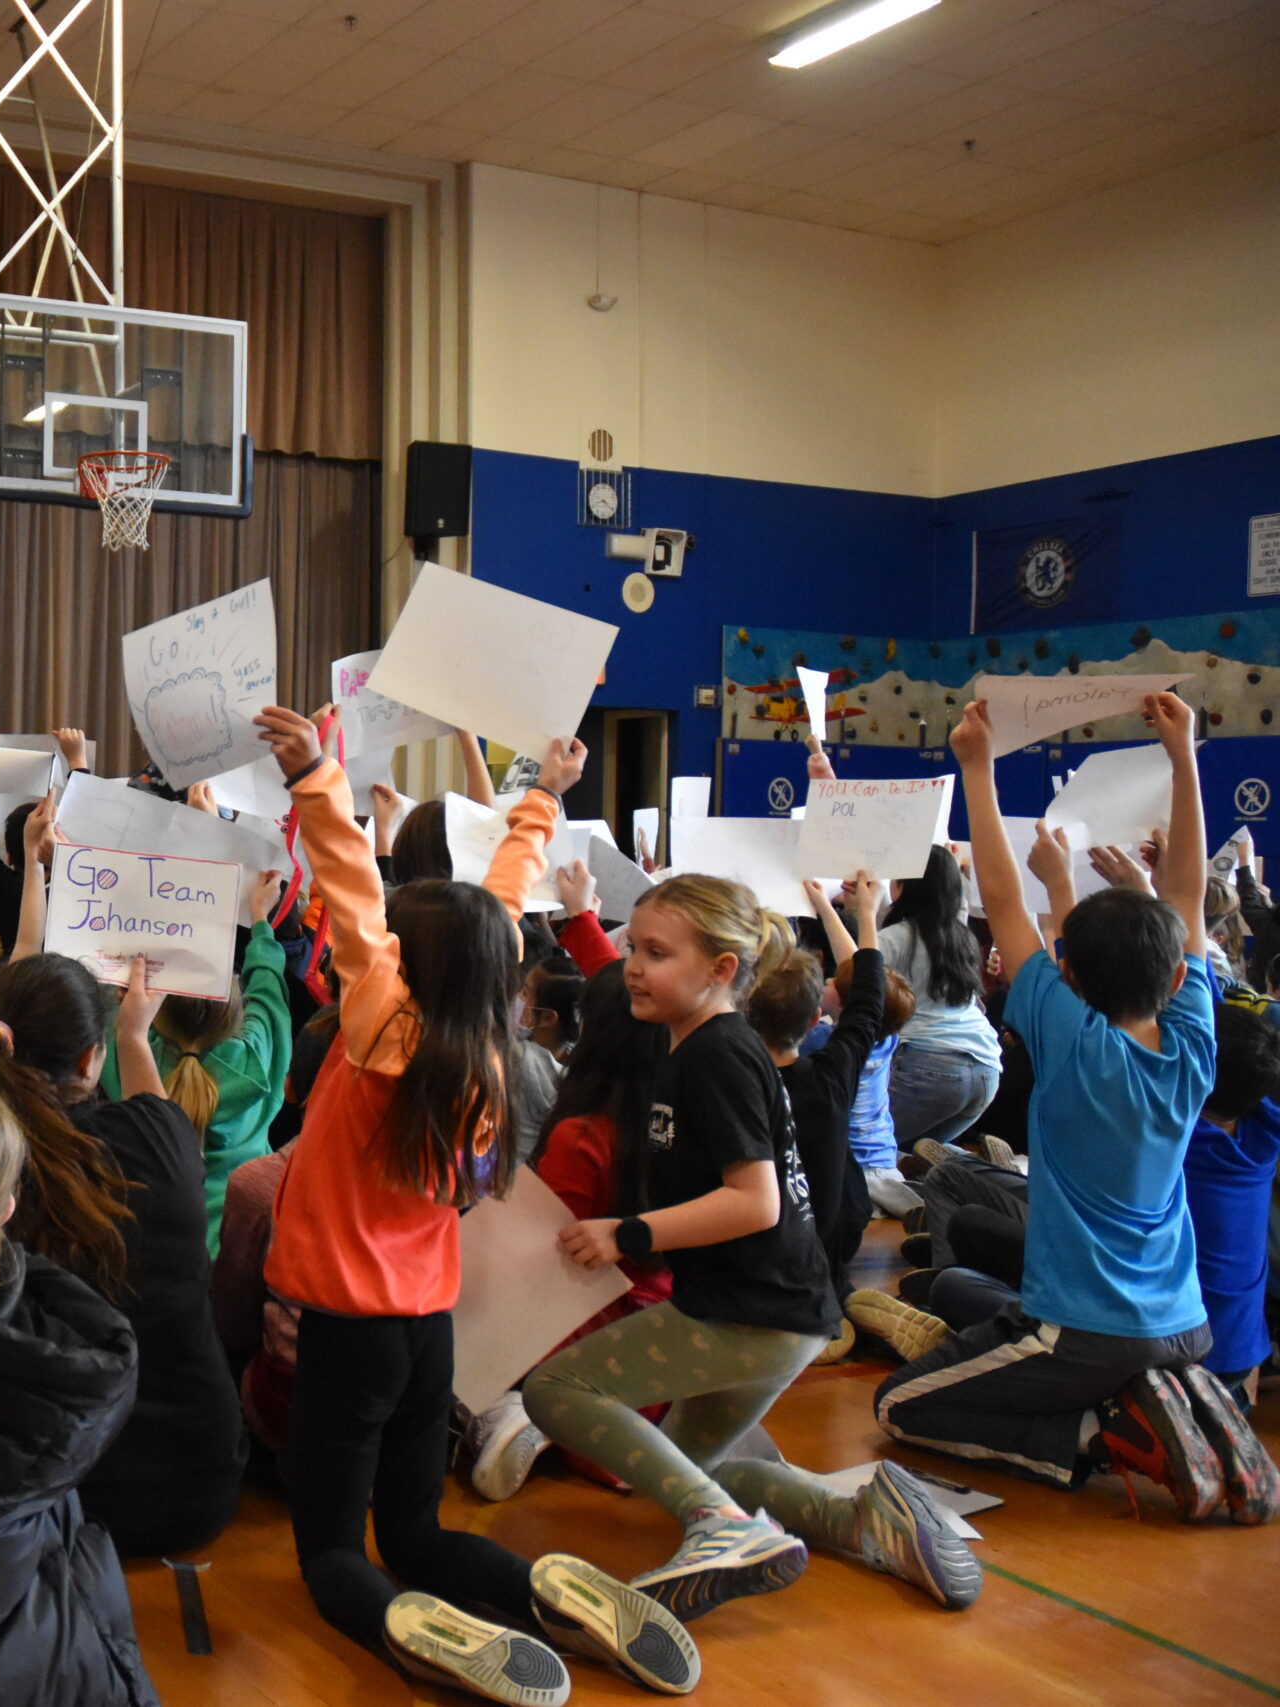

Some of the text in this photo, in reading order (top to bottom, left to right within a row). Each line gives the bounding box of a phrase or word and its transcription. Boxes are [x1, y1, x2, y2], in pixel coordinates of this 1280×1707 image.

[67, 848, 216, 905] Go Team
[67, 899, 193, 938] Johanson
